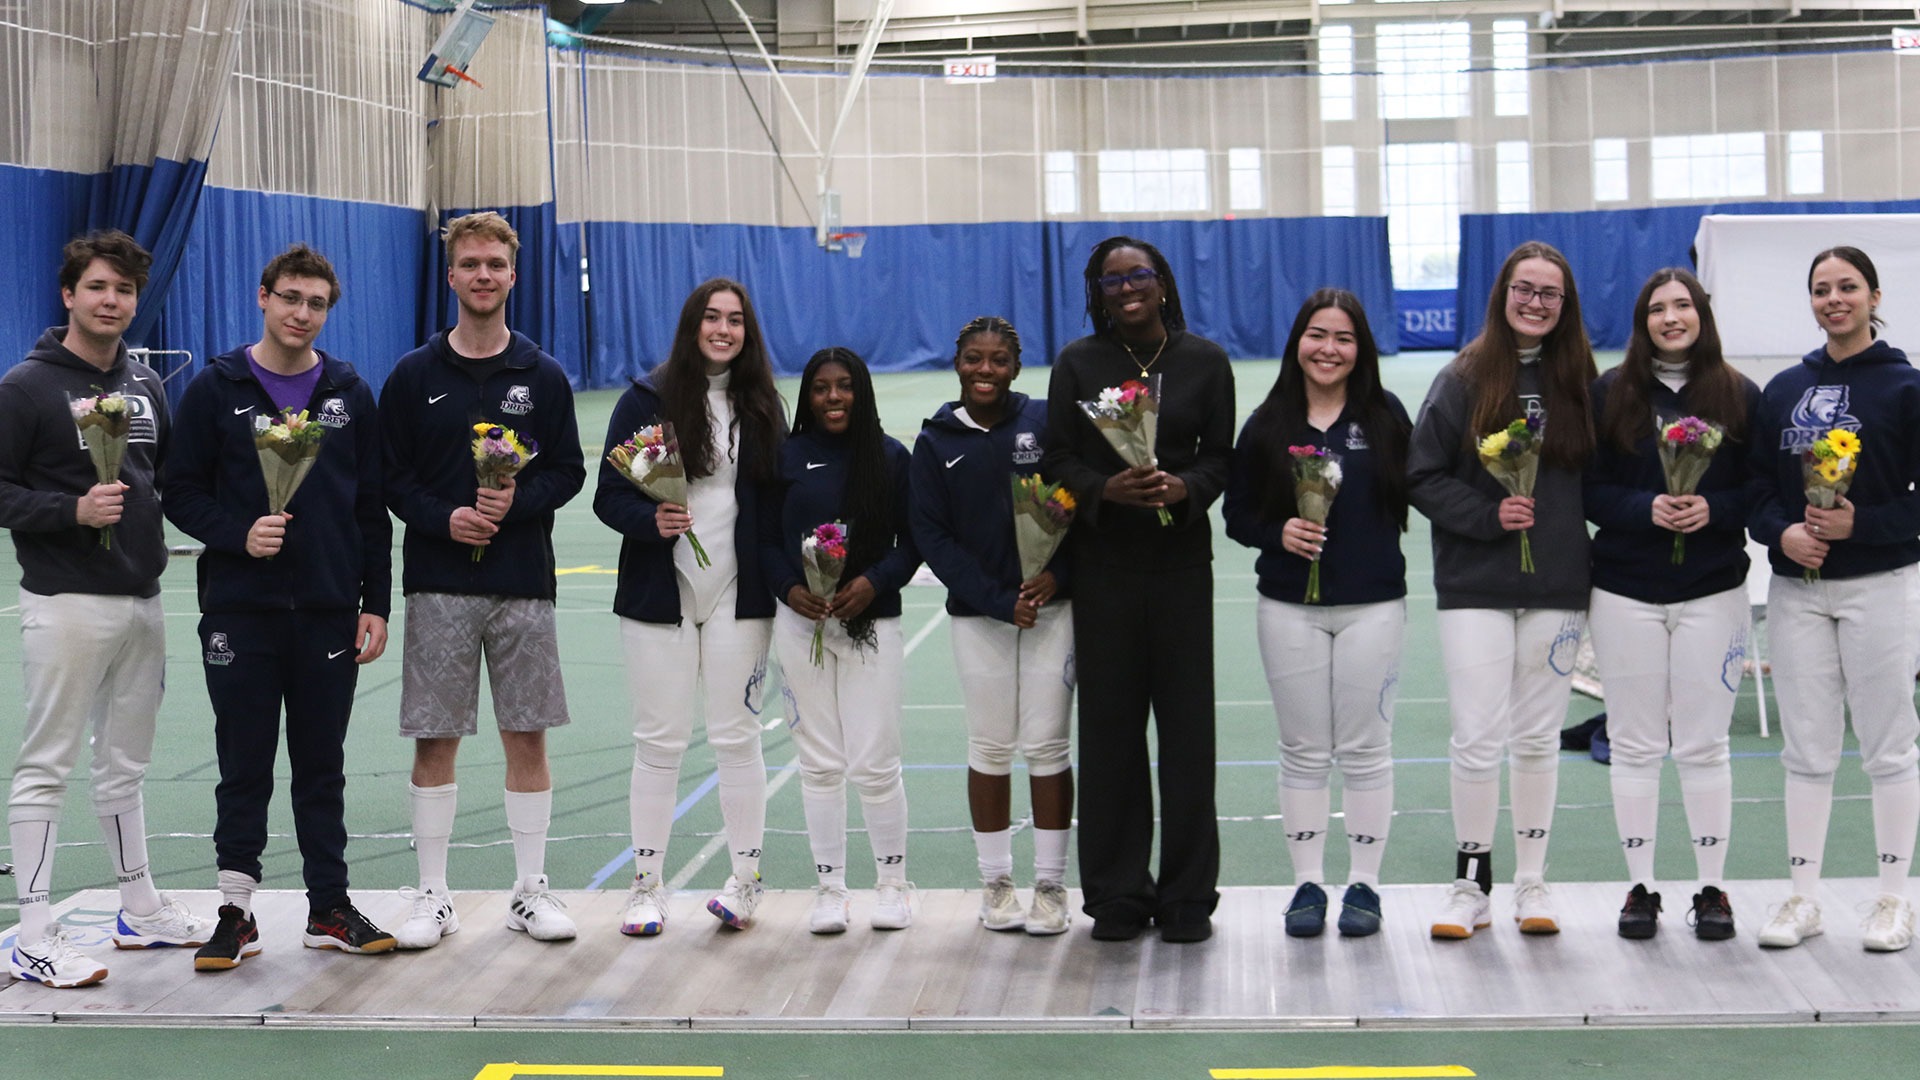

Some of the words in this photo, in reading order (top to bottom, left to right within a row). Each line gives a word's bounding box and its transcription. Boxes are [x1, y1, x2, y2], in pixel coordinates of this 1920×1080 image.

[950, 62, 988, 77] EXIT
[1405, 309, 1456, 332] DRE
[501, 401, 534, 414] DREW
[317, 412, 350, 425] DREW
[1012, 449, 1043, 461] DREW
[207, 651, 235, 663] DREW
